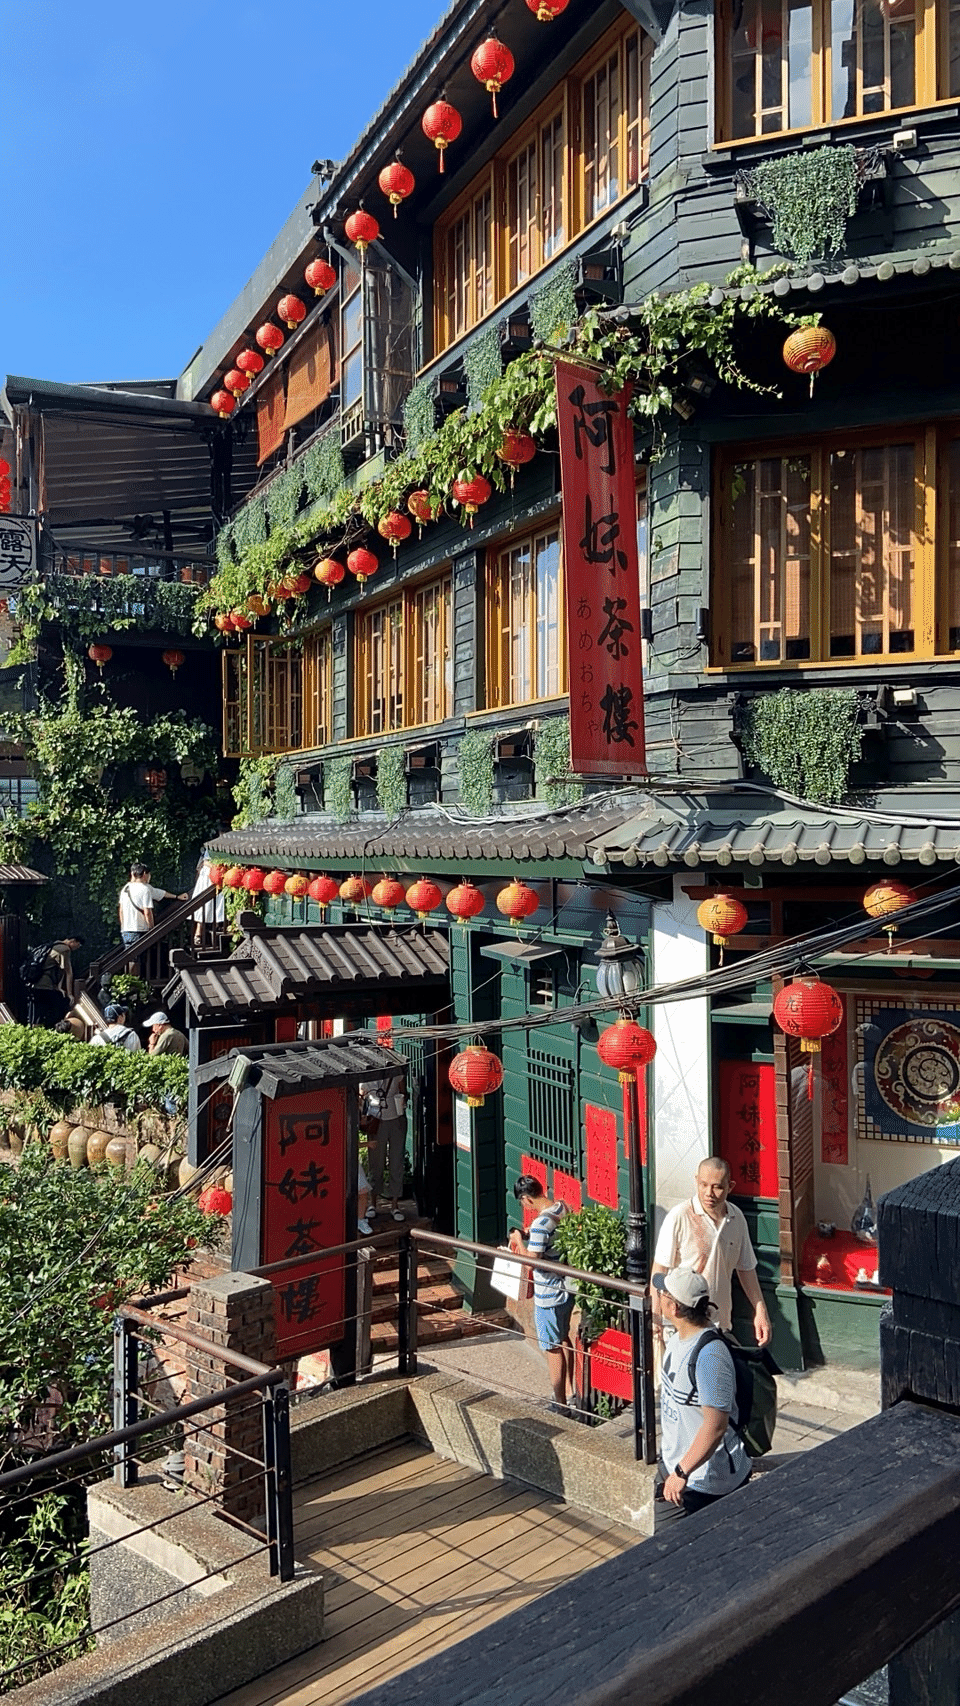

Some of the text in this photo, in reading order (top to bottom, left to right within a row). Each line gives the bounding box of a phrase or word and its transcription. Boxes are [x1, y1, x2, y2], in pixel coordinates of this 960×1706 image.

[568, 384, 638, 745] 阿妹茶樓
[576, 596, 599, 737] あめおちゃ
[278, 1110, 332, 1323] 阿妹茶樓
